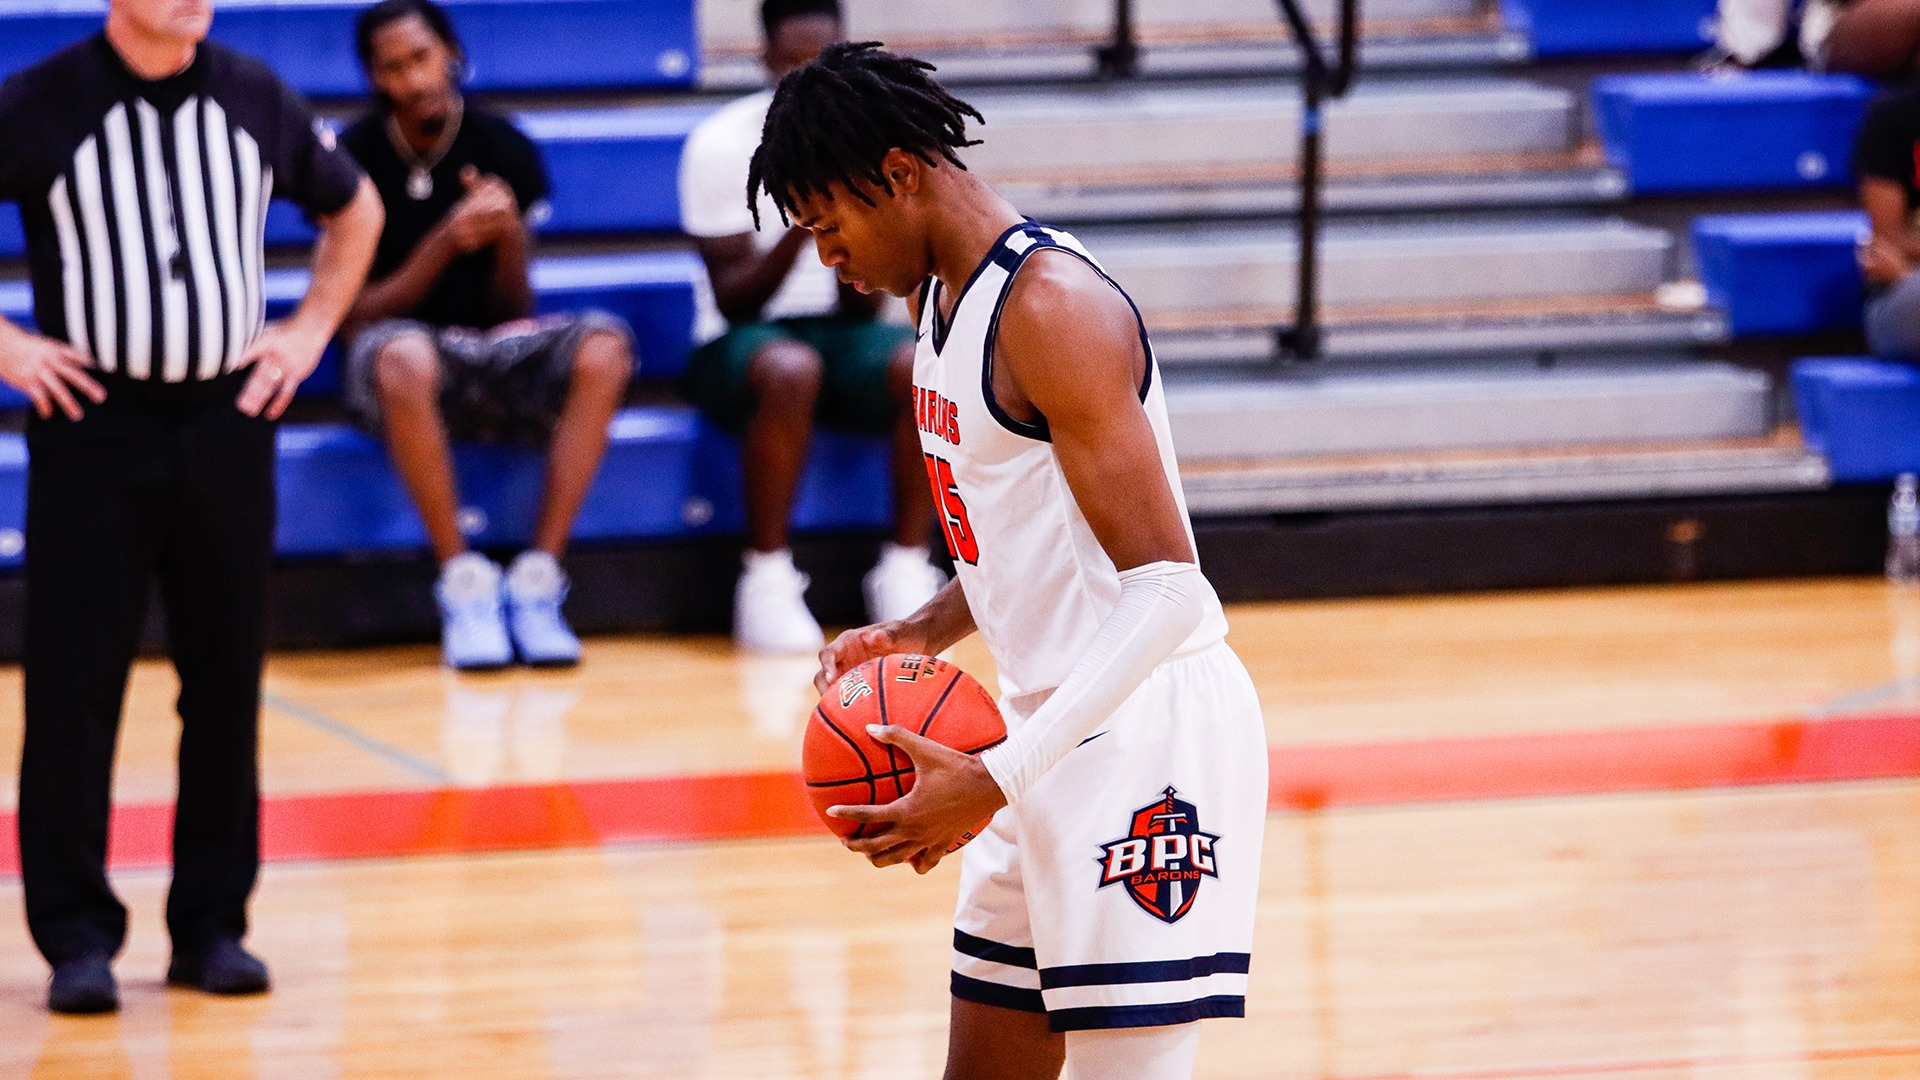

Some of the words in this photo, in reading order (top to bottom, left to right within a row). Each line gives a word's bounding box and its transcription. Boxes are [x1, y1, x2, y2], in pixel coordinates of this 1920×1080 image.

[924, 452, 980, 567] 15
[1103, 834, 1215, 882] BPC
[1131, 870, 1200, 885] BARONS
